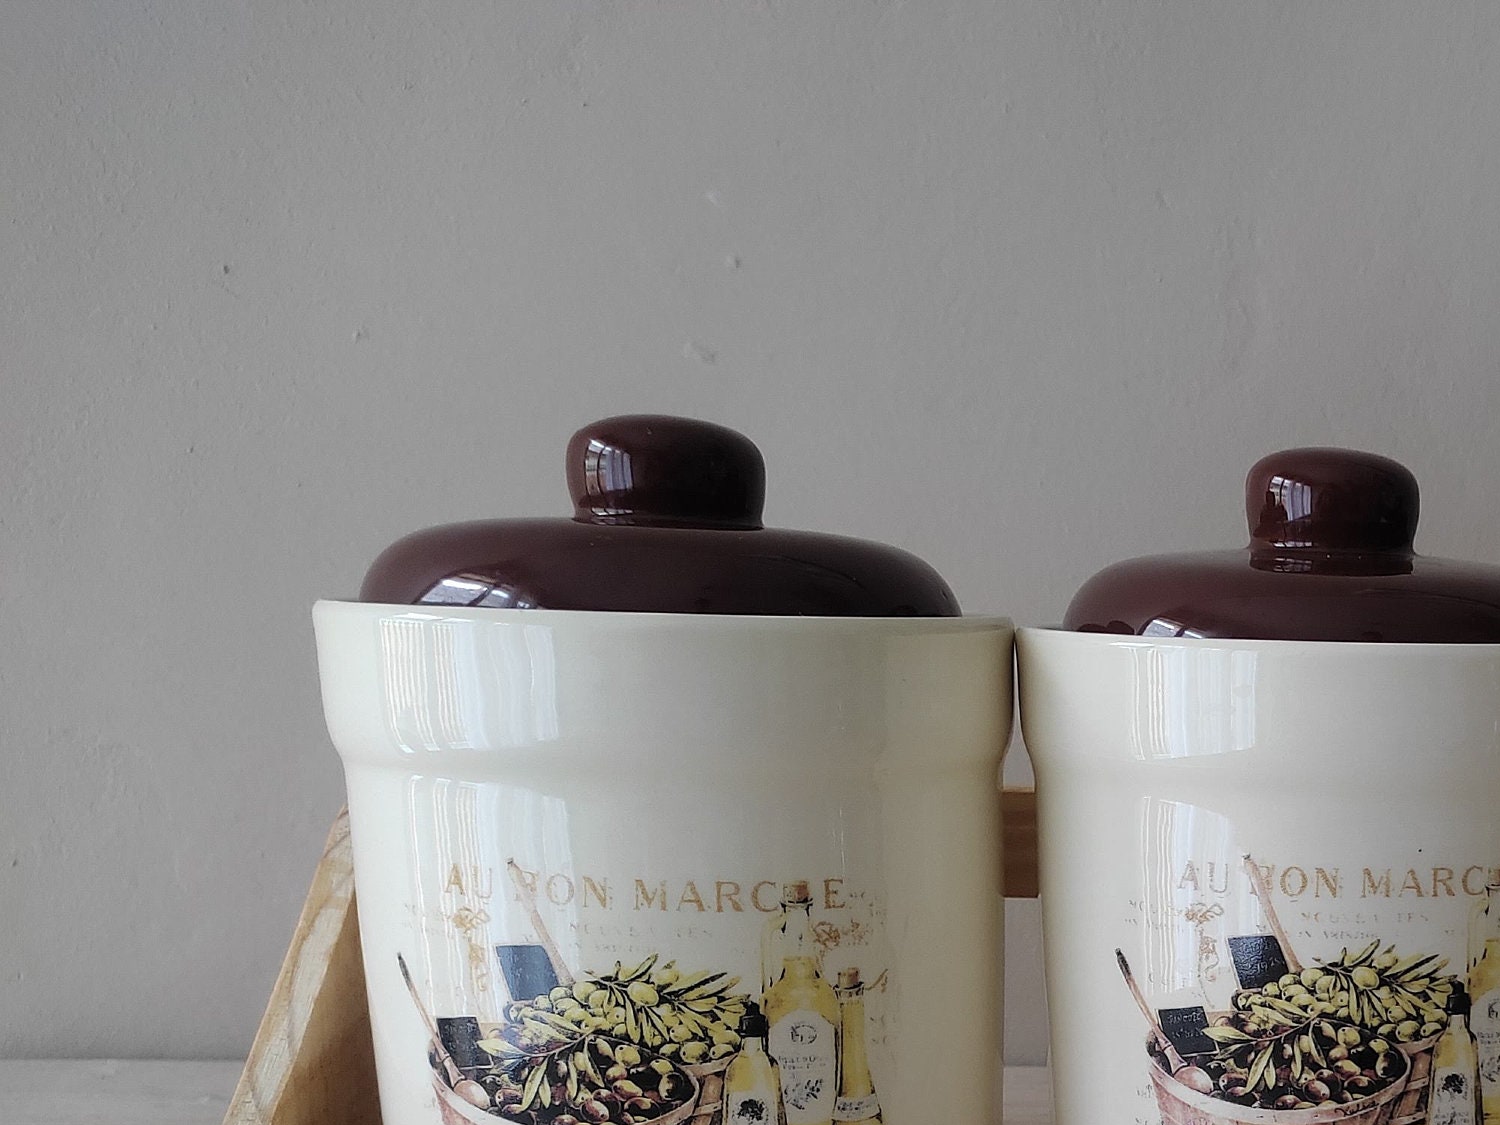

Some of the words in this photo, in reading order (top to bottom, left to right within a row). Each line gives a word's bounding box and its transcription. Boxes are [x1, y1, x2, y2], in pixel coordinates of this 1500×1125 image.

[443, 863, 493, 899] AU
[633, 877, 846, 913] MARCE
[1177, 859, 1229, 894] AU
